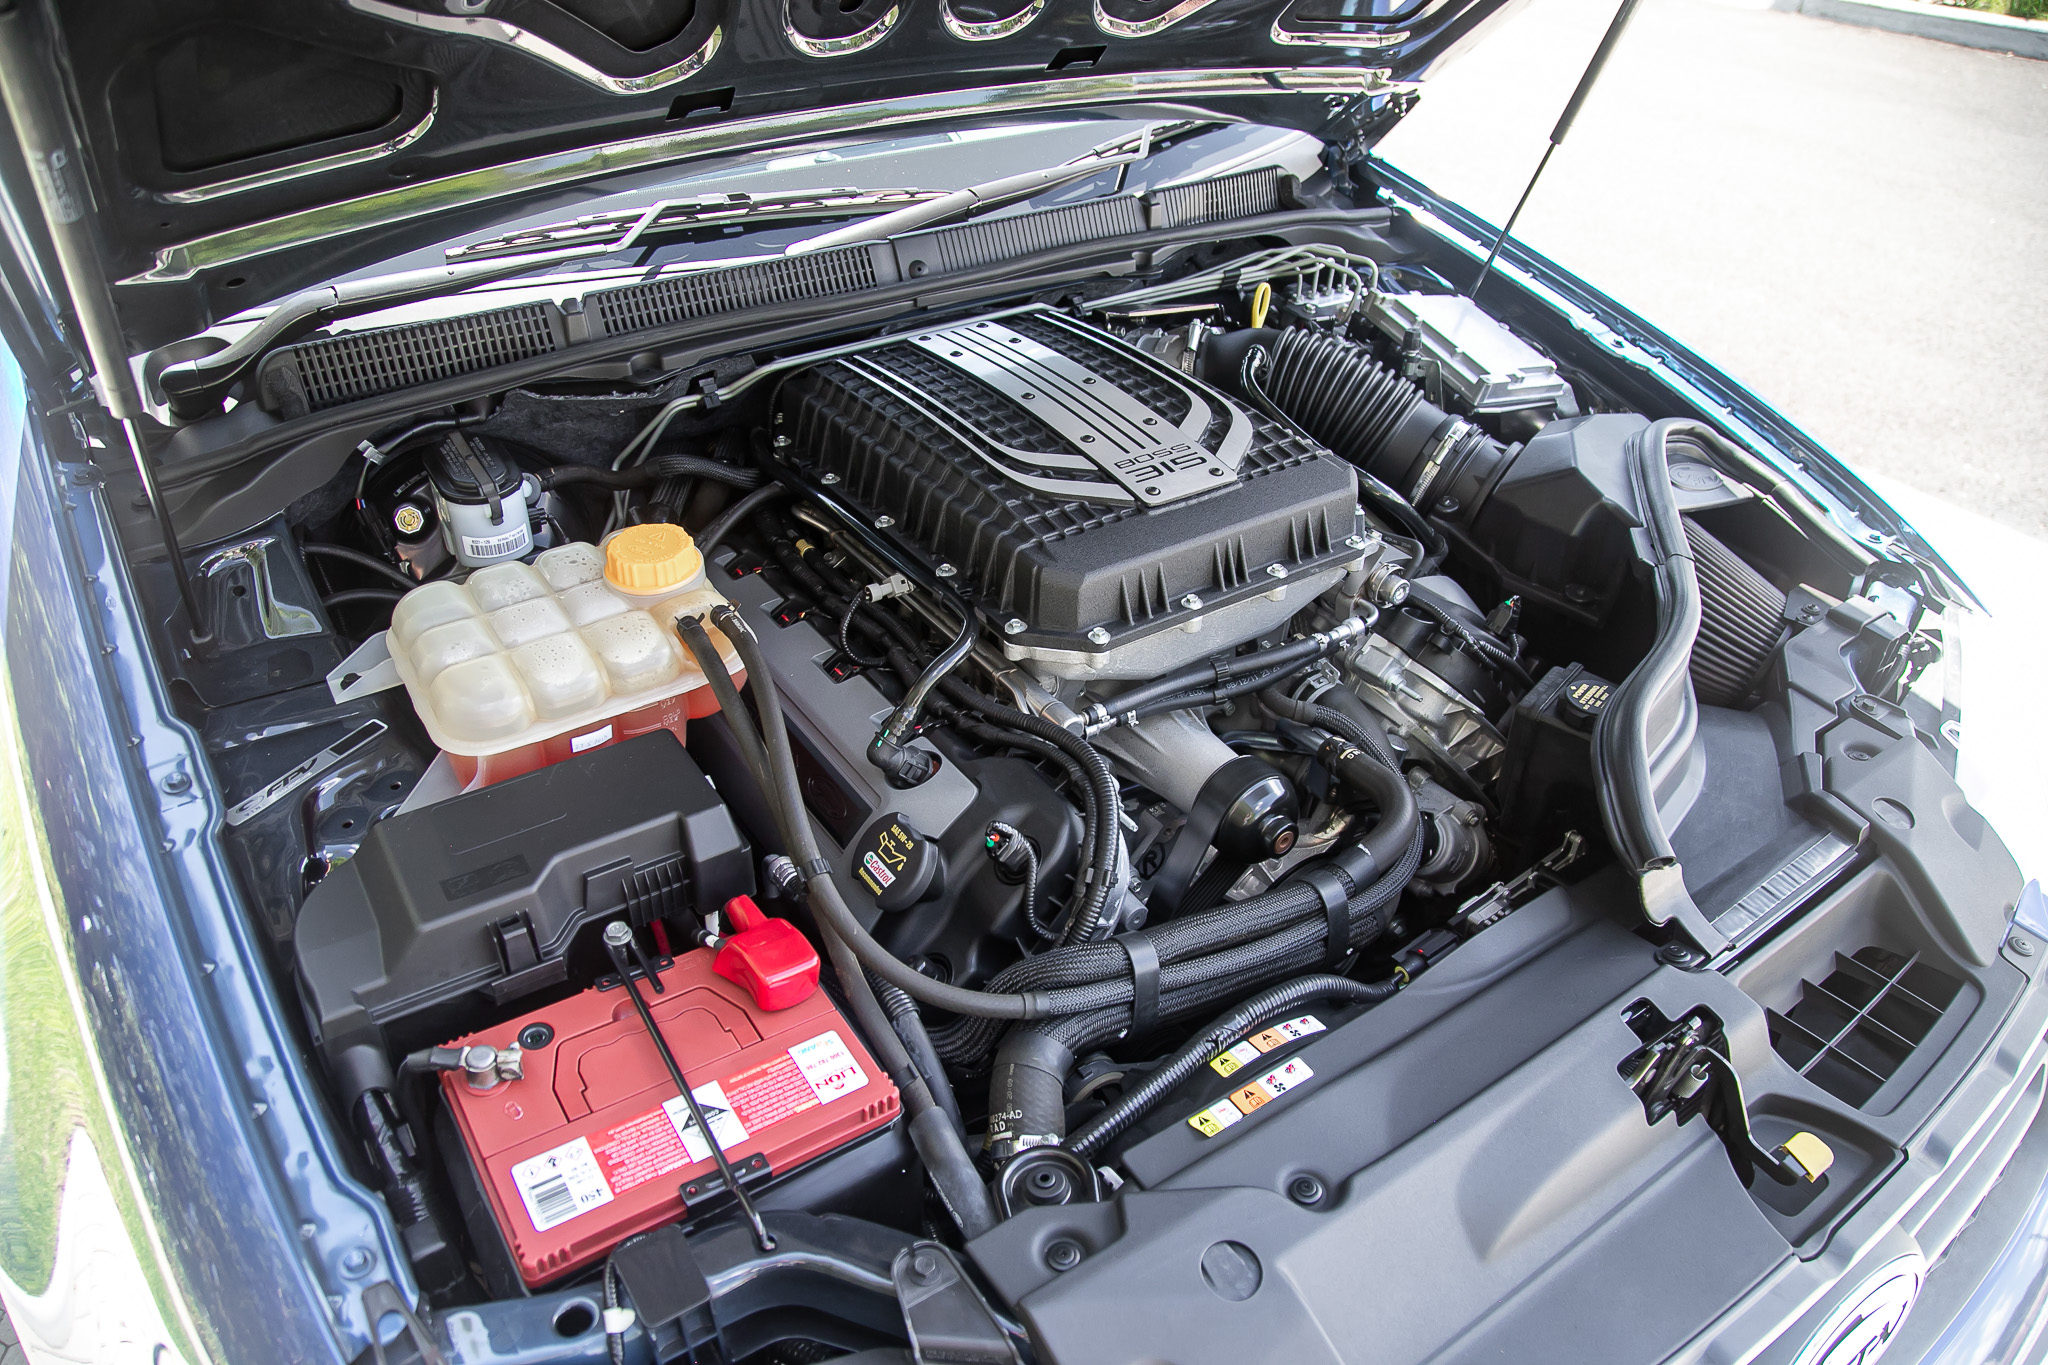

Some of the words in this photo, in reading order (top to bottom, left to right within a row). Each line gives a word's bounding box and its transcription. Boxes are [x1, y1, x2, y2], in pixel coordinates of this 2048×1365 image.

[1114, 443, 1191, 469] BOSS
[1125, 452, 1207, 483] 315
[267, 757, 316, 798] FPV
[870, 861, 893, 885] Castrol
[814, 1066, 856, 1089] LION
[579, 1187, 604, 1204] 450
